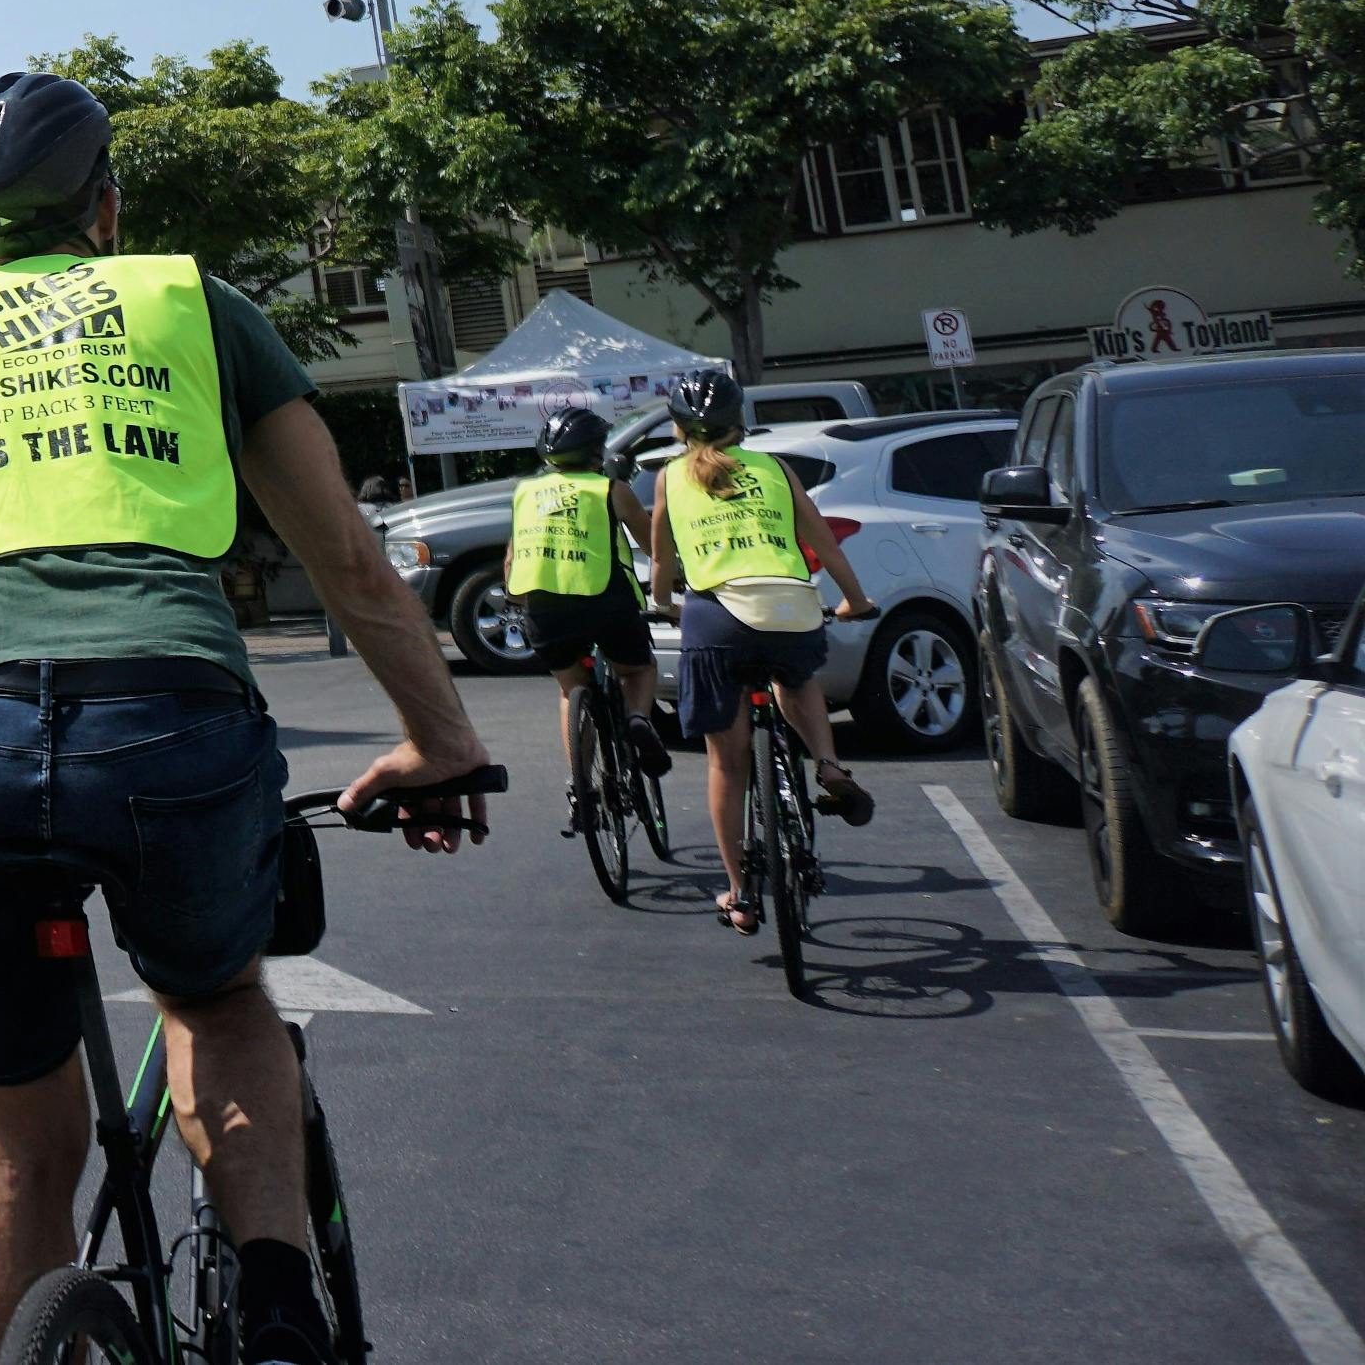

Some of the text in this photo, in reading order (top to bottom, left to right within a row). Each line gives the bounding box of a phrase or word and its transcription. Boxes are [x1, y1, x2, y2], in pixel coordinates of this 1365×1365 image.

[30, 297, 53, 310] AND
[83, 313, 125, 337] LA
[1092, 314, 1270, 357] Kip's Toyland
[942, 338, 957, 348] NO
[2, 343, 126, 369] ECOTOURISM
[21, 397, 79, 420] BACK
[84, 395, 95, 409] 3
[103, 395, 154, 416] FEET
[22, 423, 93, 462] THE
[103, 423, 180, 465] LAW
[728, 536, 755, 551] THE
[758, 533, 788, 551] LAW
